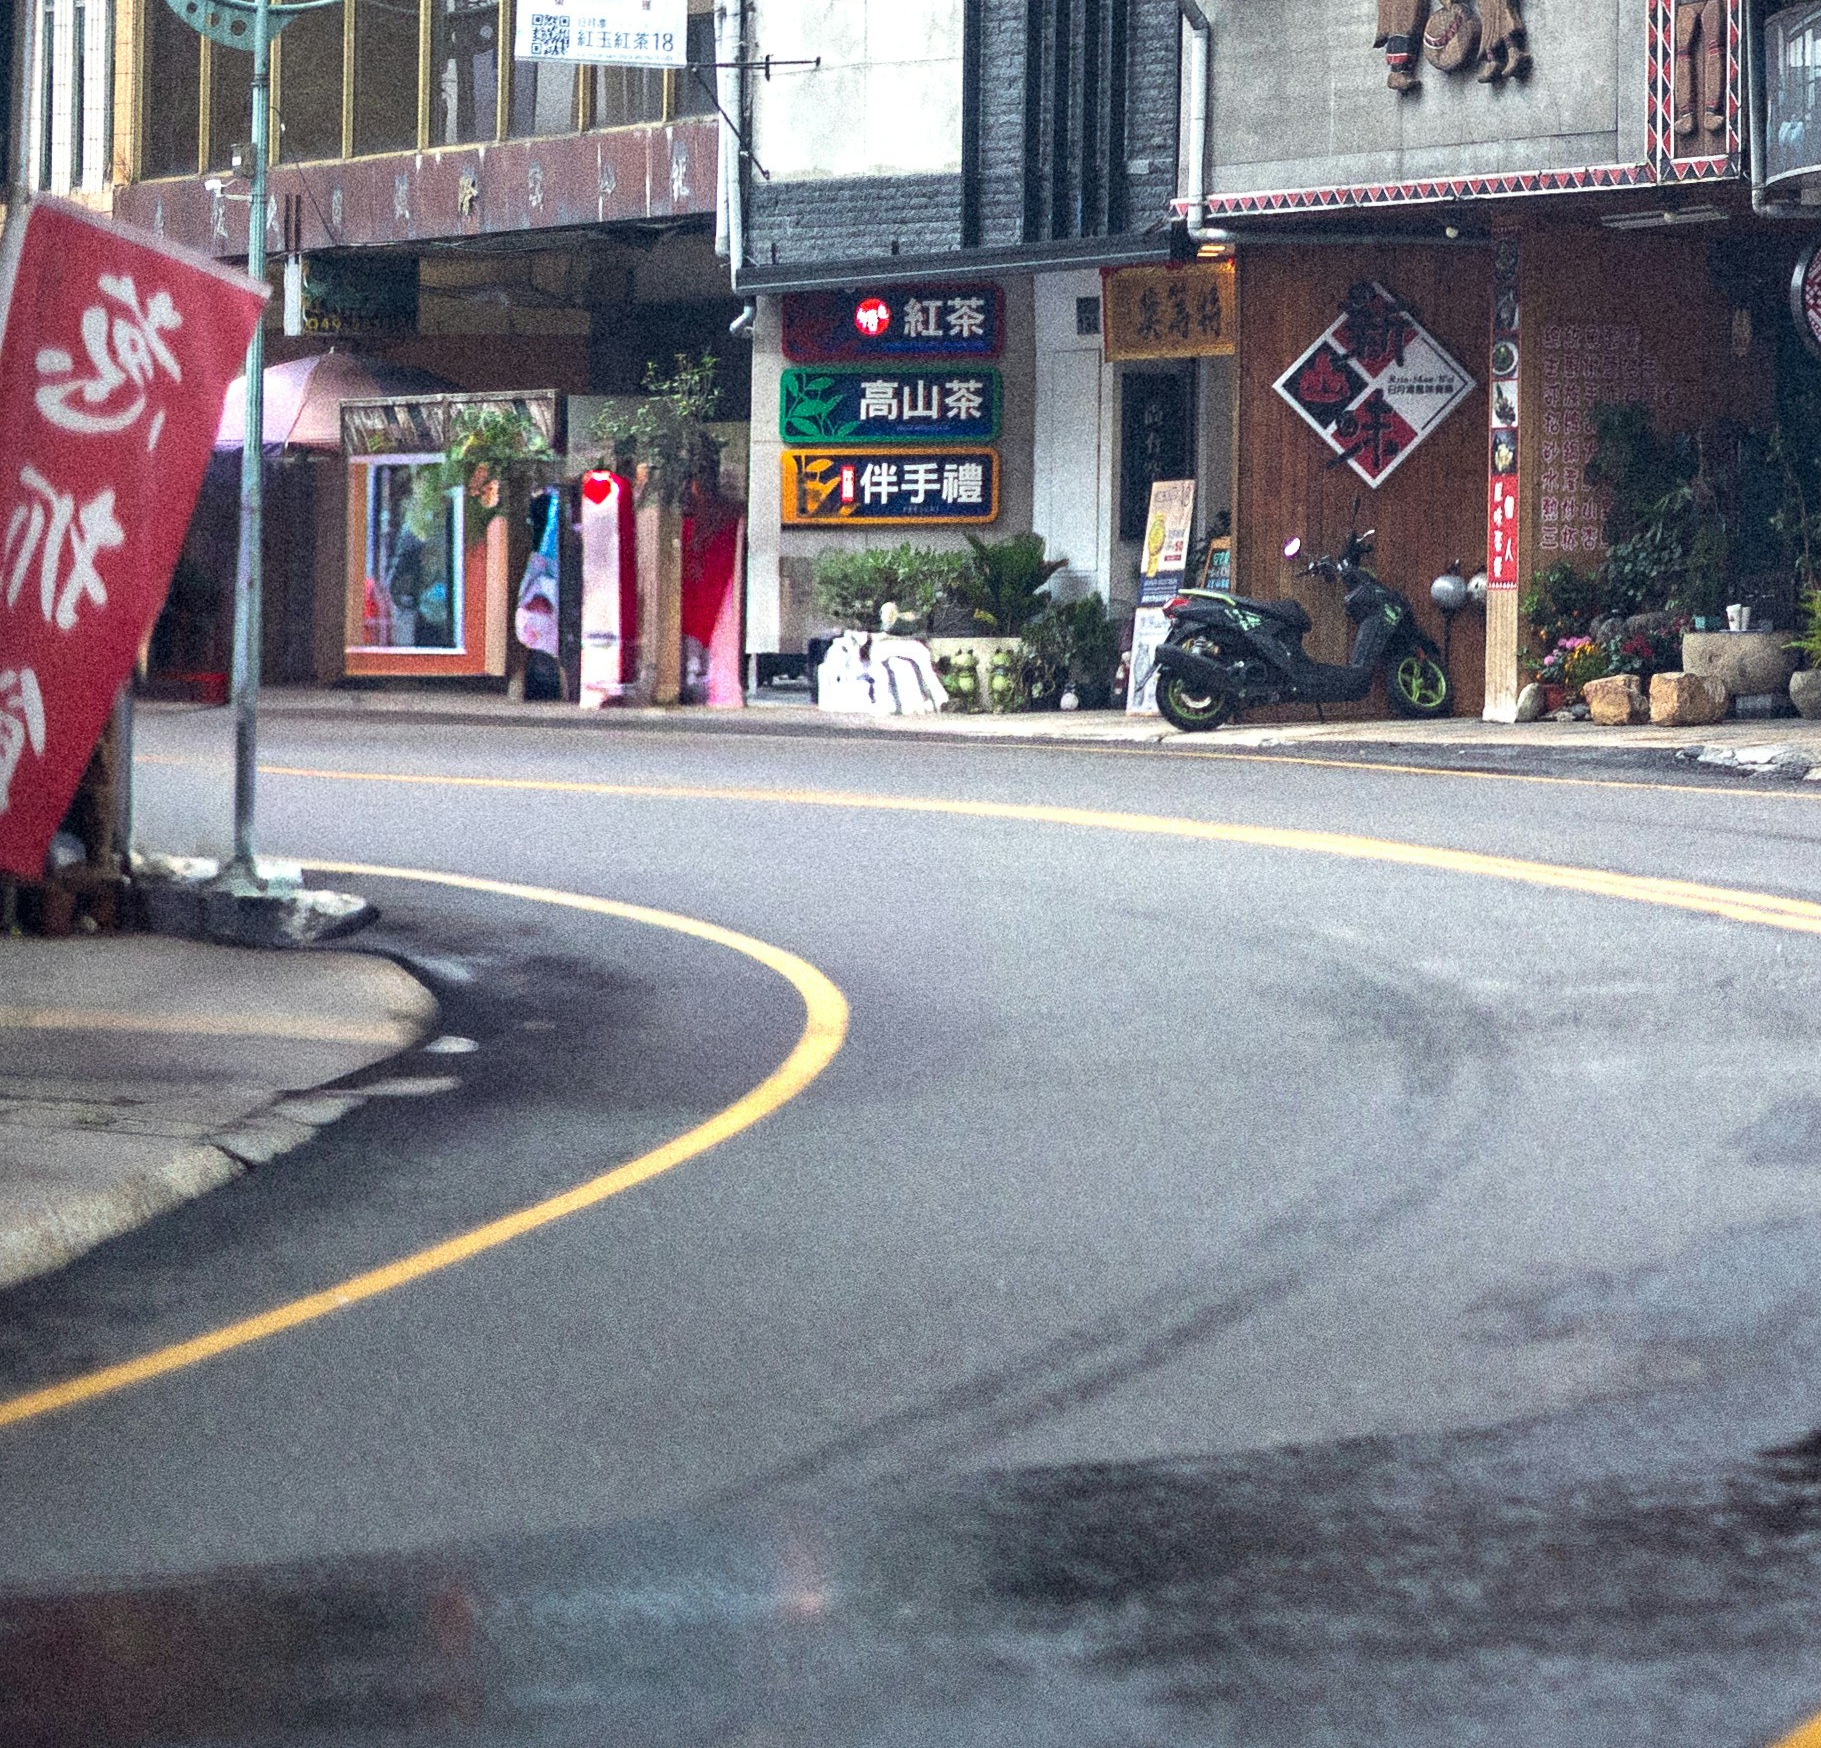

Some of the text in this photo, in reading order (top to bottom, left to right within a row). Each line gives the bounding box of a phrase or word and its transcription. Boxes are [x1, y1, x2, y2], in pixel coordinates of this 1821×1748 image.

[904, 298, 985, 338] 紅茶
[859, 380, 983, 420] 高山茶
[860, 463, 983, 504] 伴手禮
